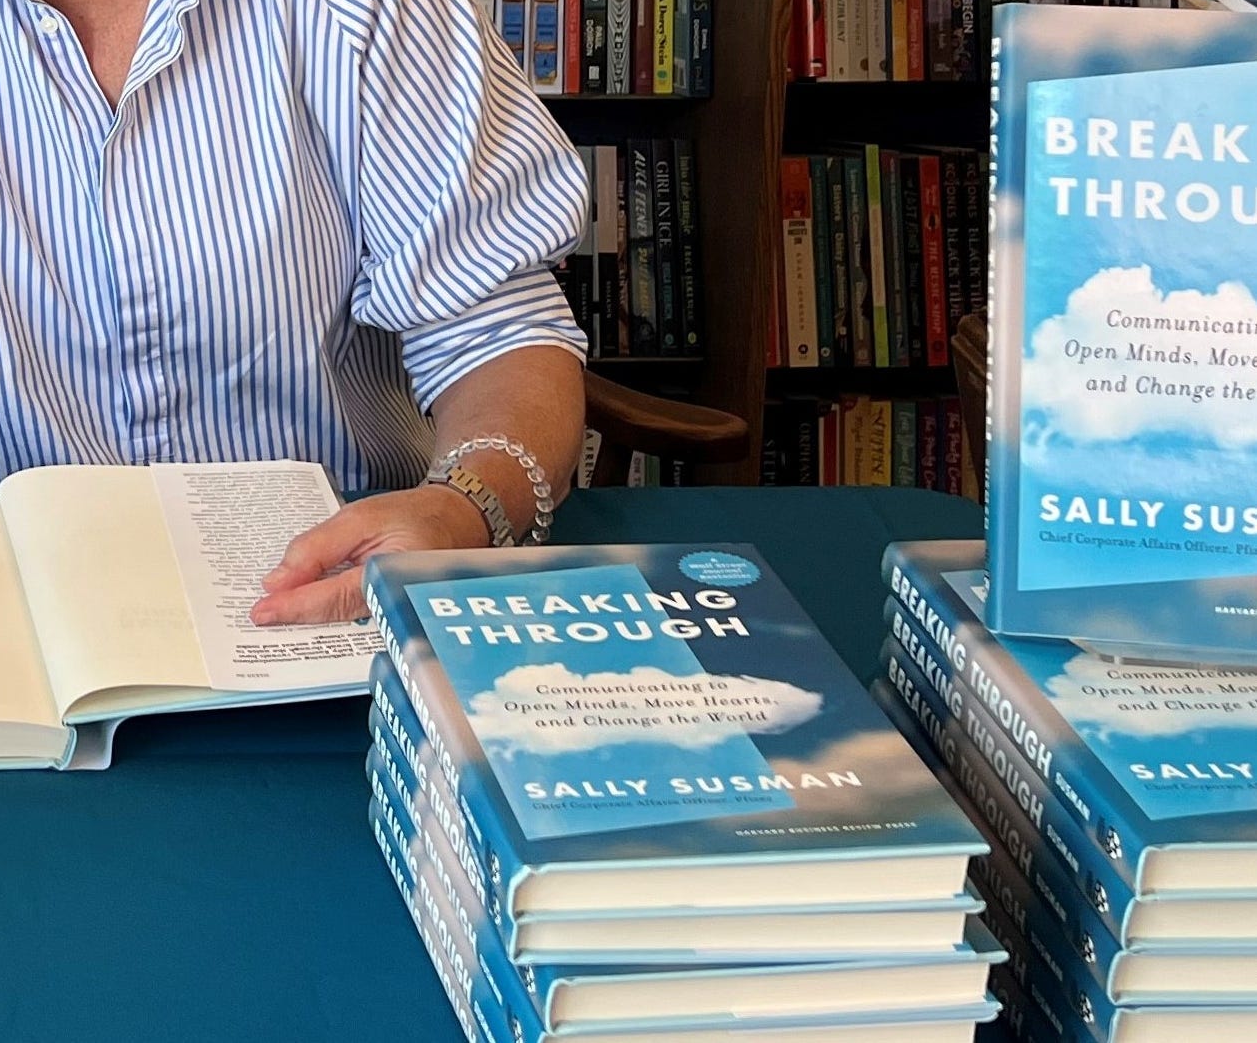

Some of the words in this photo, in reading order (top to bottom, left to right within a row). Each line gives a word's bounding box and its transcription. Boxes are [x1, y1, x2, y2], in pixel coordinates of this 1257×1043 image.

[1045, 117, 1255, 161] BREAK
[1040, 495, 1164, 528] SALLY
[431, 590, 738, 616] BREAKING
[446, 617, 750, 645] THROUGH
[891, 565, 966, 671] BREAKING
[971, 662, 1052, 777] THROUGH
[525, 779, 651, 799] SALLY
[673, 771, 862, 793] SUSMAN
